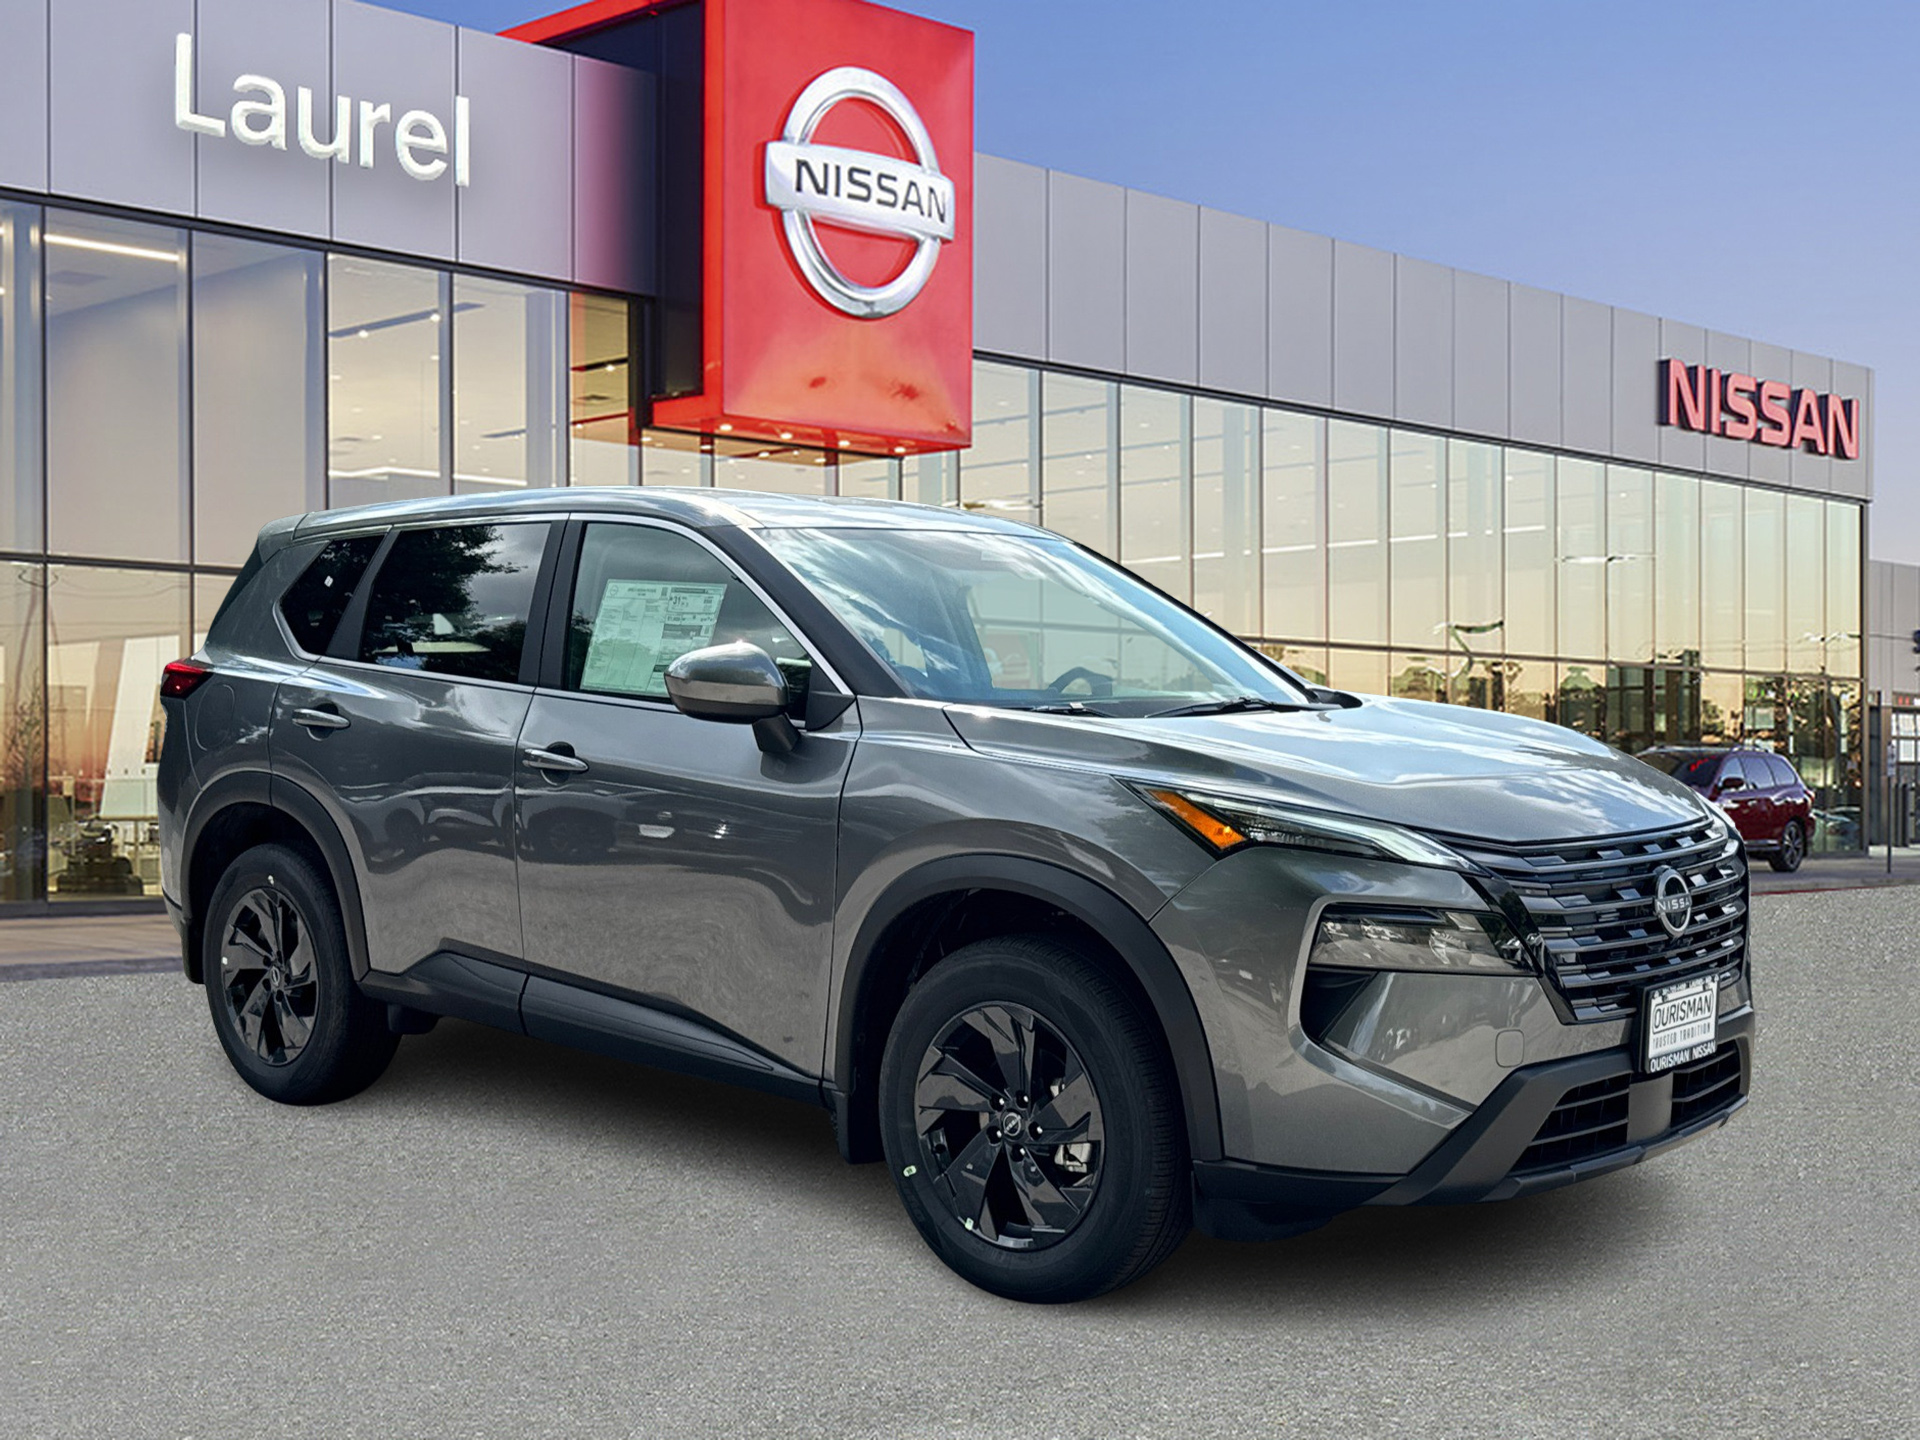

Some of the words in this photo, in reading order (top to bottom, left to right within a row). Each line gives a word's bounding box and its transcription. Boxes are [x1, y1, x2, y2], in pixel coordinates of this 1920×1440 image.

[175, 33, 470, 187] Laurel
[796, 159, 946, 223] NISSAN
[1664, 358, 1860, 460] NISSAN
[1653, 994, 1712, 1029] OURISMAN
[1653, 1032, 1677, 1049] TRUSTED
[1680, 1022, 1711, 1040] TRADITION
[1650, 1049, 1690, 1073] OURISMAN
[1692, 1040, 1716, 1060] NISSAN
